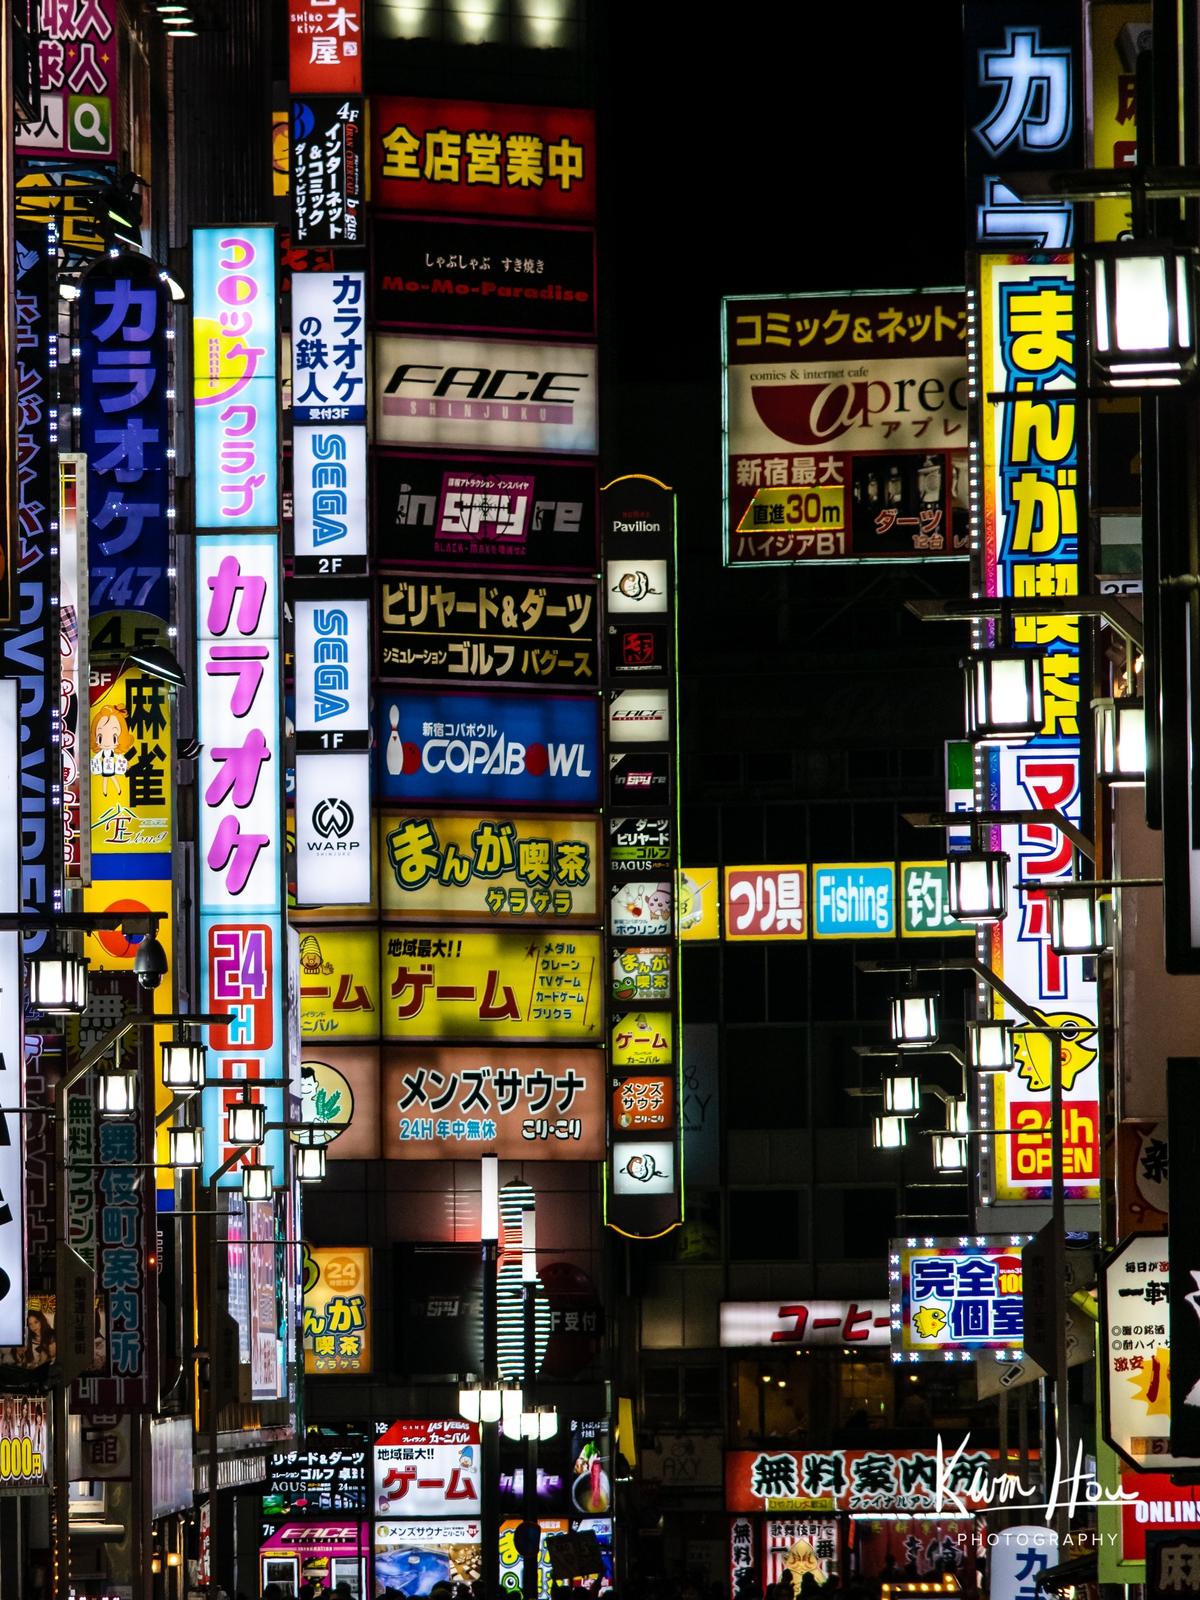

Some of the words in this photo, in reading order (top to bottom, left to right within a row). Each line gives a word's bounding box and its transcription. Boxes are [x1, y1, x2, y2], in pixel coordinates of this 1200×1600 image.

[336, 102, 359, 122] 4F
[382, 126, 584, 190] 全店営業中
[308, 145, 325, 226] &コミック
[325, 122, 343, 240] インターネット
[424, 253, 491, 271] しゃぶしゃぶ
[501, 256, 546, 274] すき焼き
[382, 276, 590, 303] Mo-Mo-Paradise
[332, 274, 364, 403] カラオケ
[296, 316, 329, 404] の鉄人
[383, 364, 590, 403] FACE
[750, 369, 786, 381] comics
[789, 370, 800, 380] &
[803, 367, 845, 379] internet
[847, 366, 869, 378] cafe
[92, 279, 160, 557] カラオケ
[308, 408, 349, 420] 受付3F
[409, 400, 548, 422] SHINJUKU
[736, 455, 844, 487] 新宿最大
[312, 433, 348, 548] SEGA
[753, 493, 841, 526] 直進30m
[612, 520, 661, 533] Pavilion
[874, 508, 943, 535] ダーツ
[736, 532, 846, 557] ハイジアB1
[318, 558, 343, 573] 2F
[90, 566, 161, 606] 747
[382, 582, 593, 635] ビリヤード&ダーツ
[313, 608, 350, 723] SEGA
[383, 648, 447, 666] シミュレーション
[448, 640, 515, 677] ゴルフ
[521, 650, 593, 678] バグース
[205, 555, 272, 895] カラオケ
[125, 673, 168, 808] 麻雀
[319, 733, 344, 749] 1F
[635, 818, 669, 832] ダーツ
[307, 841, 360, 851] WARP
[617, 832, 670, 846] ビリヤード
[388, 818, 590, 892] まんが喫茶
[636, 847, 670, 859] ゴルフ
[611, 860, 652, 871] BAGUS
[485, 887, 573, 917] ゲラゲラ
[729, 872, 803, 931] つり具
[819, 874, 889, 935] Fishing
[387, 938, 462, 959] 地域最大!!
[543, 943, 576, 955] メダル
[540, 958, 581, 971] クレーン
[620, 953, 669, 975] まんが
[390, 962, 523, 1022] ゲーム
[535, 991, 584, 1004] カードゲーム
[615, 1031, 669, 1050] ゲーム
[397, 1066, 585, 1114] メンズサウナ
[622, 1082, 664, 1096] メンズ
[621, 1097, 665, 1110] サウナ
[399, 1120, 433, 1140] 24H
[436, 1119, 497, 1140] 年中無休
[327, 1262, 357, 1280] 24
[913, 1257, 998, 1301] 完全
[313, 1336, 360, 1356] 喫茶
[315, 1359, 361, 1370] ゲラゲラ
[427, 1422, 443, 1433] LAS
[443, 1421, 471, 1432] VEGAS
[377, 1448, 434, 1461] 地域最大!!
[300, 1468, 335, 1480] ゴルフ
[382, 1465, 478, 1502] ゲーム
[262, 1524, 276, 1537] 7F
[281, 1527, 358, 1539] FACE
[389, 1526, 442, 1537] メンズサウナ
